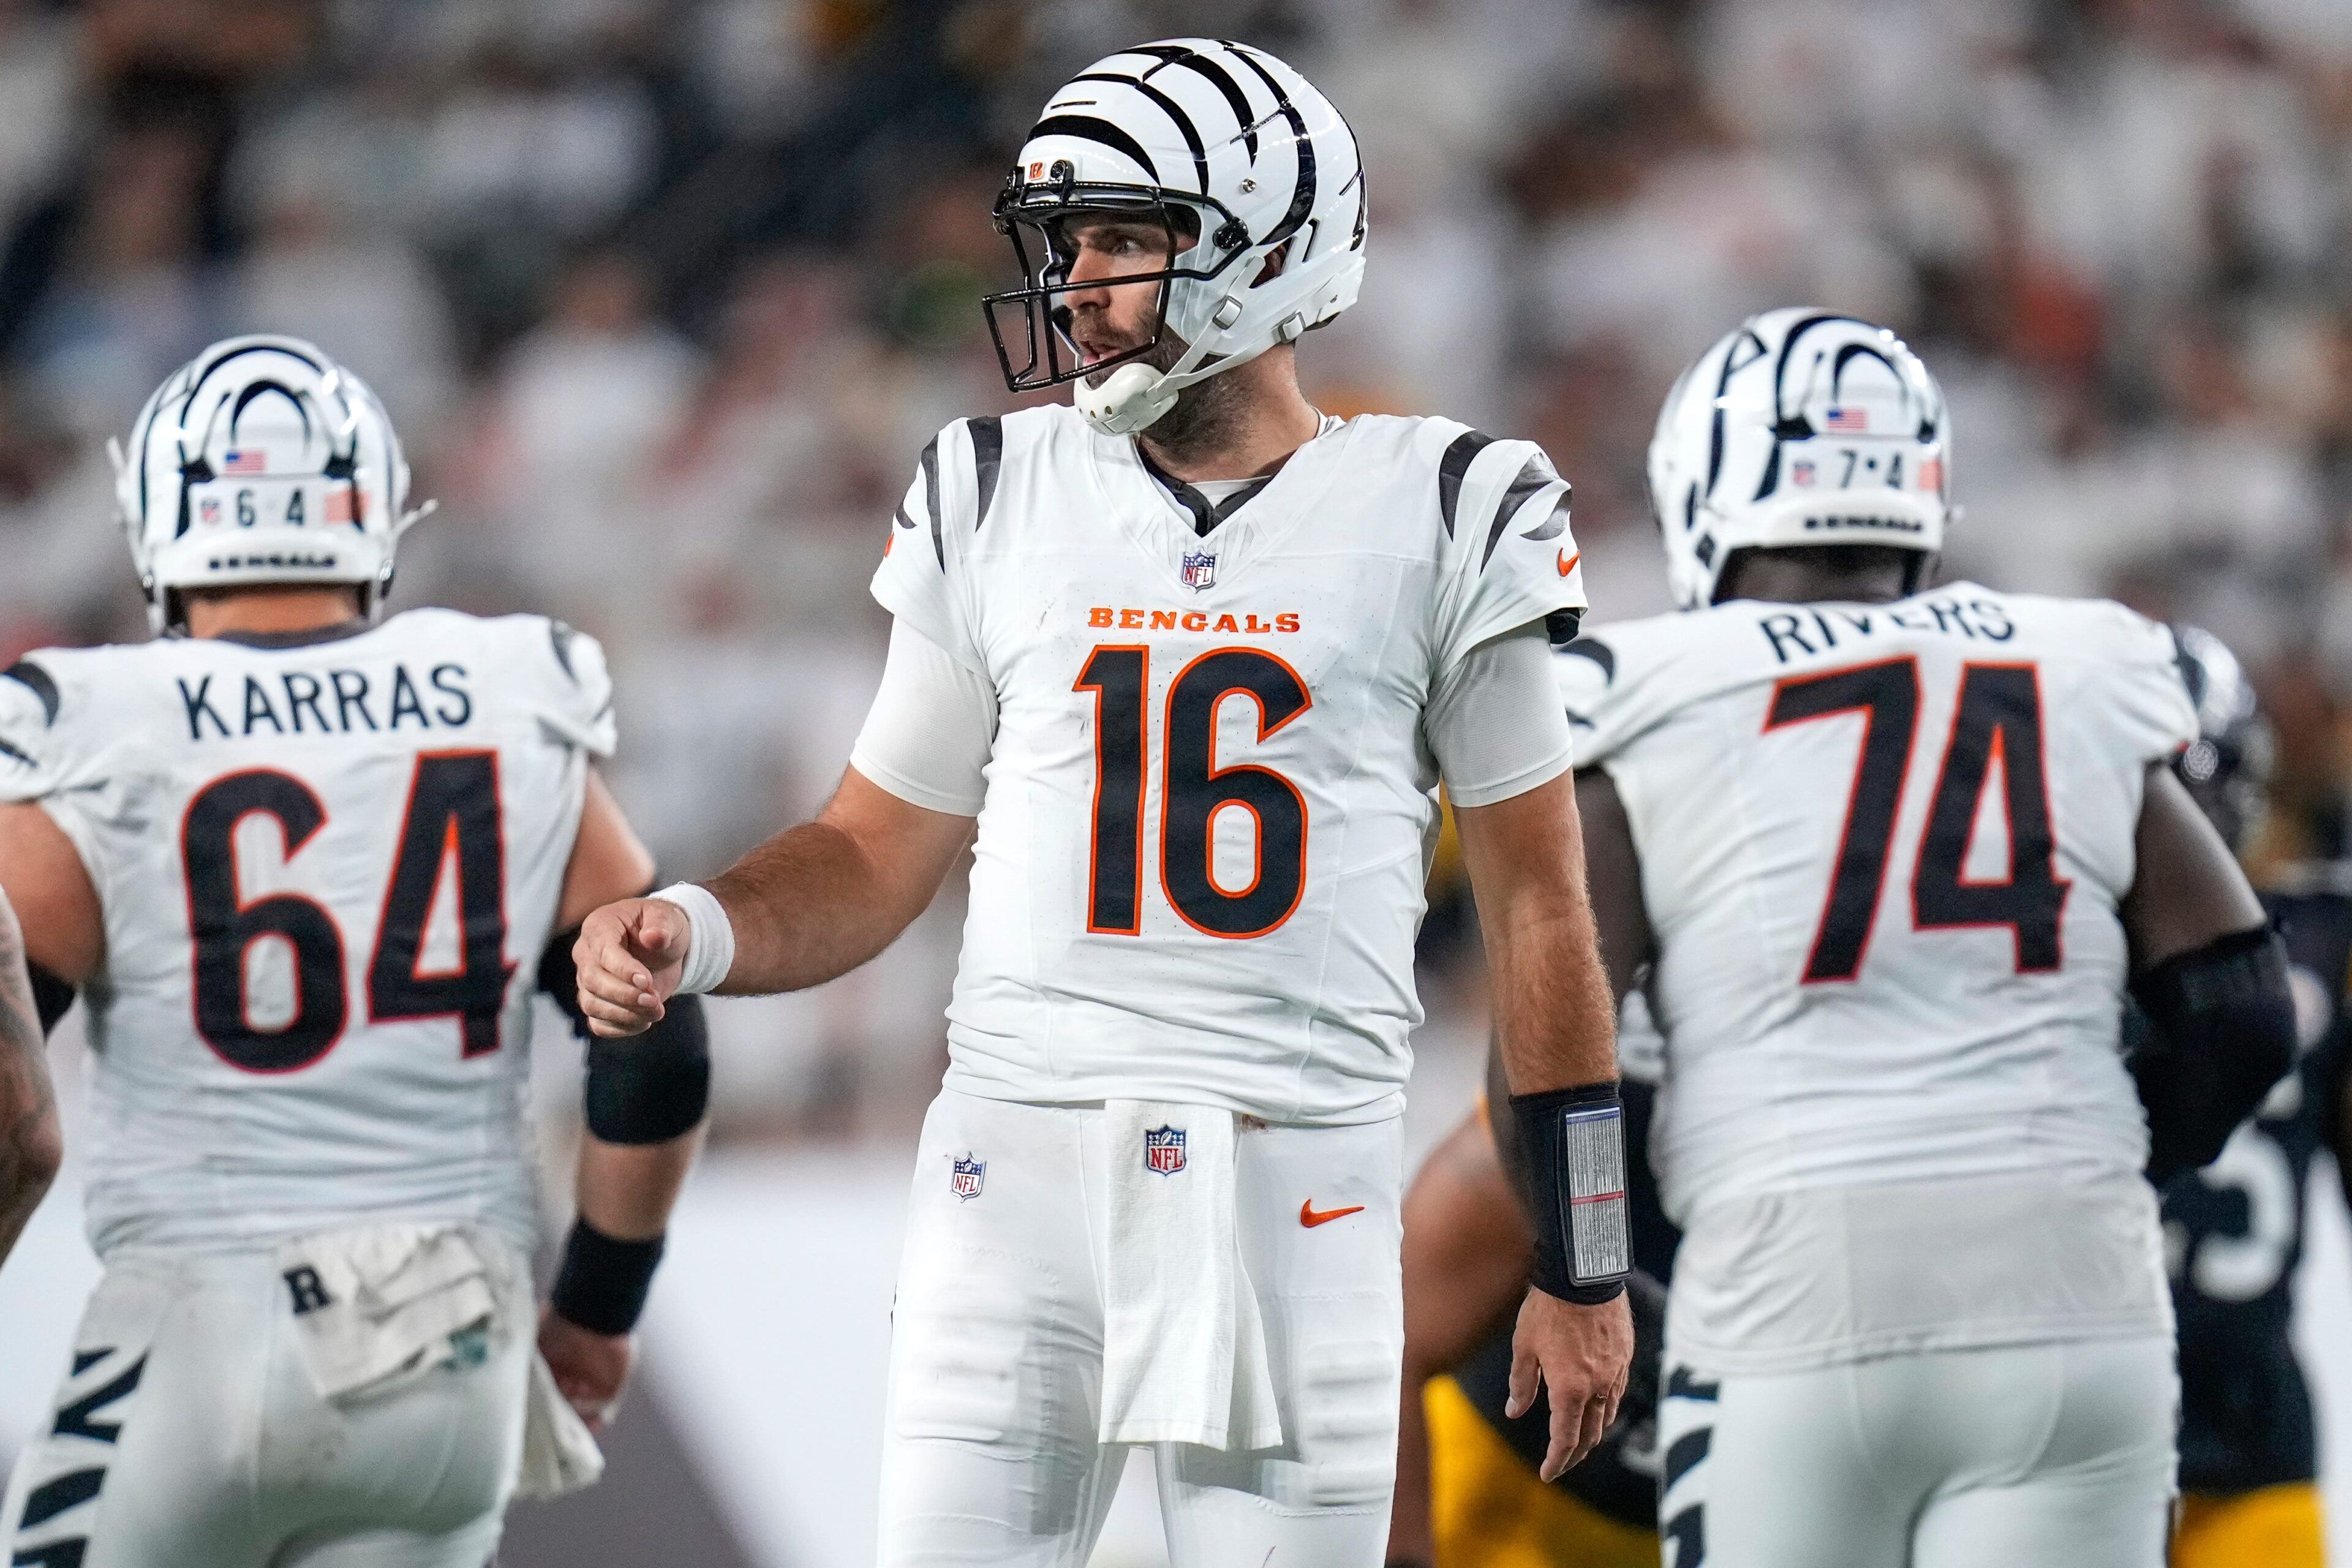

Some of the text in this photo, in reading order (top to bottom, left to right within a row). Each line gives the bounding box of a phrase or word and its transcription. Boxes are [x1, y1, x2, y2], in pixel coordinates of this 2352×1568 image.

[1184, 567, 1210, 584] NFL
[1088, 608, 1301, 633] BENGALS
[178, 663, 472, 740] KARRAS
[1072, 644, 1313, 940] 16
[1762, 654, 2071, 985] 74
[181, 748, 518, 1074] 64
[954, 1174, 977, 1193] NFL
[1151, 1147, 1183, 1171] NFL
[282, 1263, 334, 1316] R
